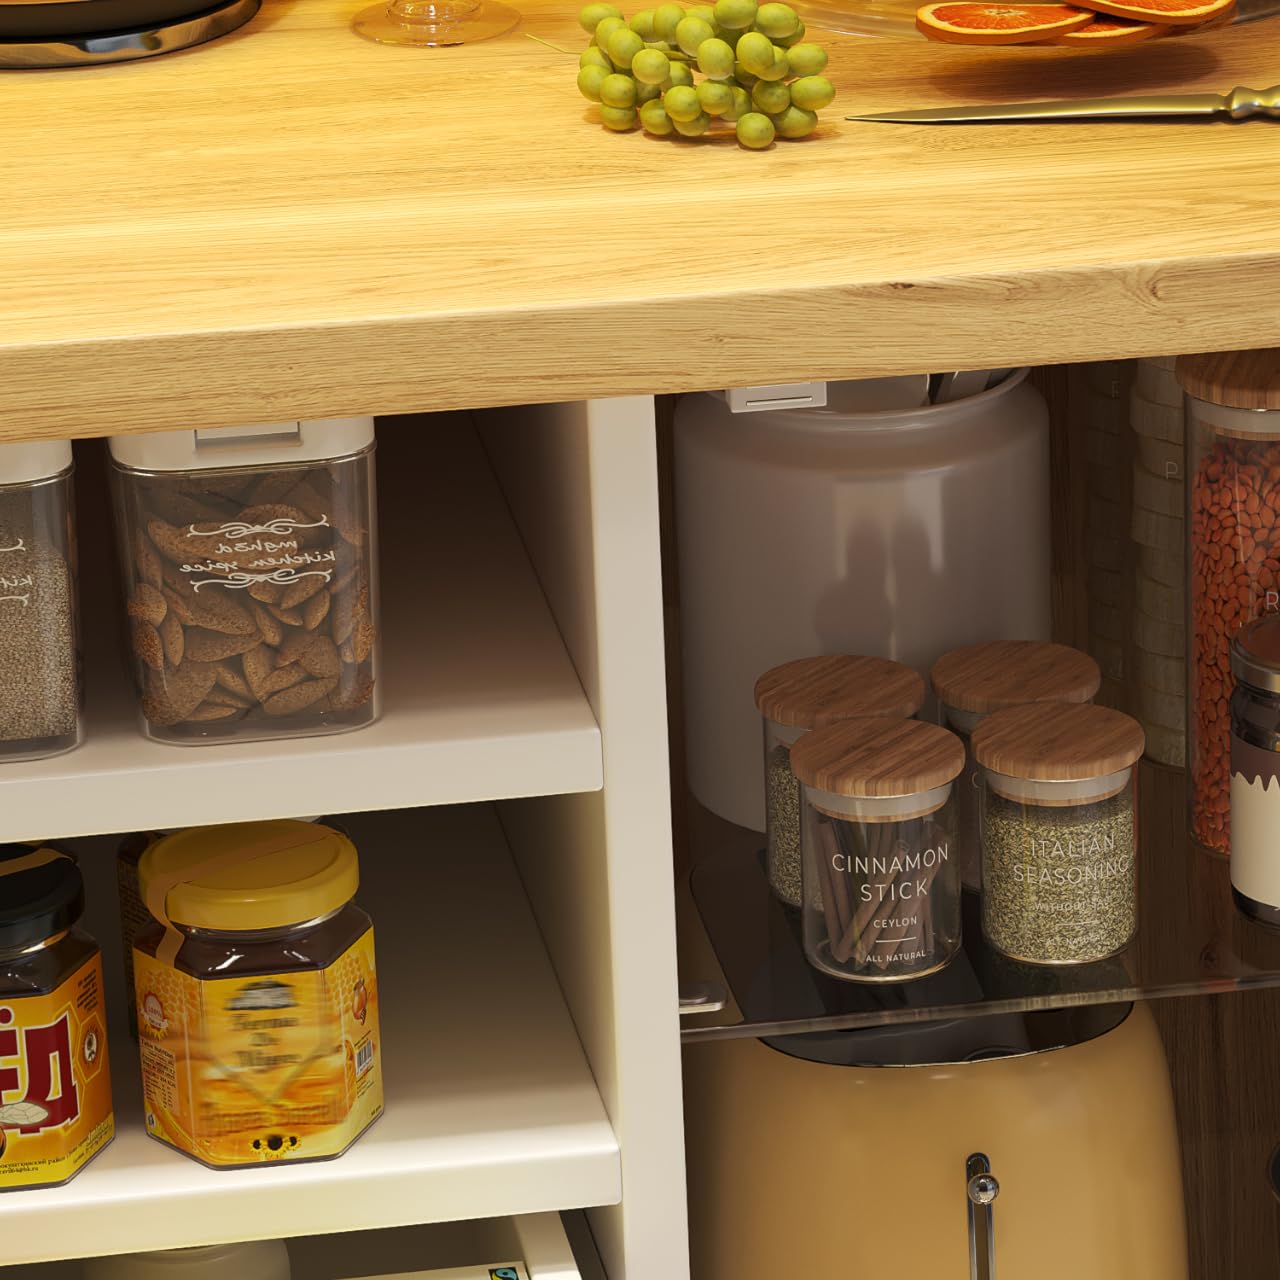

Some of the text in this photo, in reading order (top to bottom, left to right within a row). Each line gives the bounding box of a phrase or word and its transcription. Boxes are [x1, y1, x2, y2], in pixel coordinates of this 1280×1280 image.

[1031, 832, 1115, 858] ITALIAN
[832, 843, 949, 875] CINNAMON
[1013, 855, 1129, 885] SEASONING
[860, 878, 928, 902] STICK
[873, 916, 917, 928] CEYLON
[866, 950, 926, 962] ALL NATURAL
